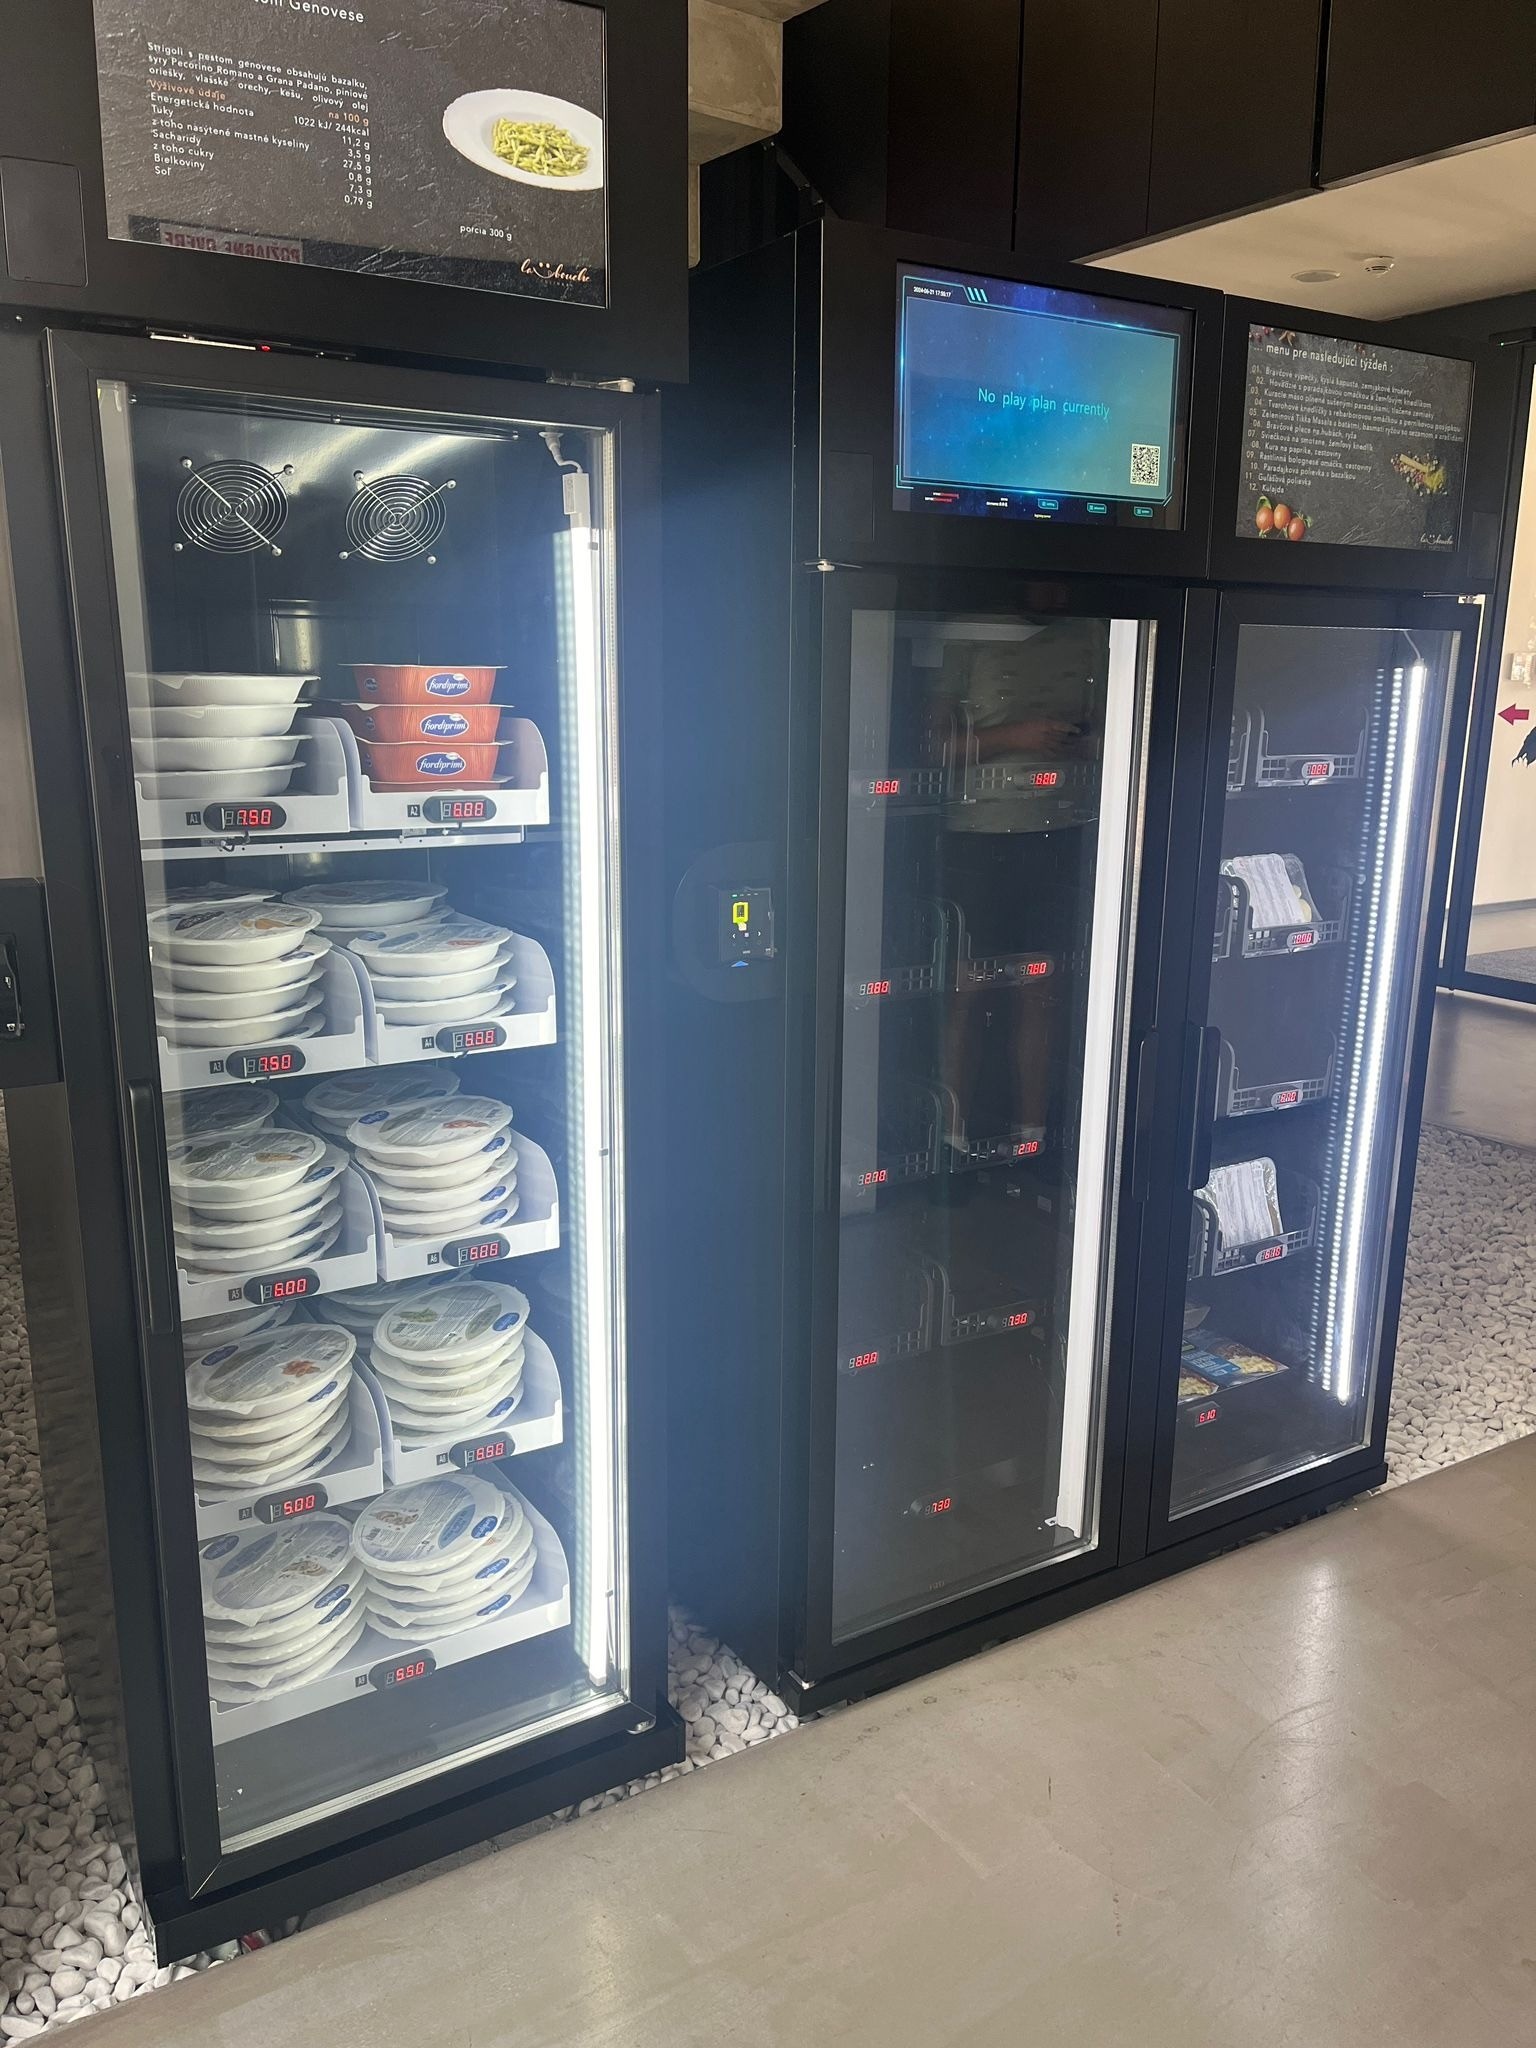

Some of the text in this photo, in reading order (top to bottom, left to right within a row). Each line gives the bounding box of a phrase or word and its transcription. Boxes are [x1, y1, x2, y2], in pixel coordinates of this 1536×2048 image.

[289, 0, 364, 23] Genovese
[148, 42, 183, 56] Strigoli
[198, 52, 233, 64] pestom
[238, 60, 282, 74] genovese
[287, 68, 327, 82] obsahujú
[331, 75, 368, 90] bazalku,
[148, 55, 167, 67] syry
[171, 58, 213, 73] Pecorino
[217, 66, 254, 79] Romano
[266, 74, 294, 87] Grana
[296, 80, 333, 95] Padano,
[335, 87, 368, 100] piniové
[149, 80, 226, 101] Výživové údaje
[195, 74, 229, 87] vlašské
[238, 82, 272, 95] orechy,
[280, 88, 303, 101] kešu,
[312, 95, 344, 108] olivový
[352, 102, 369, 113] olej
[150, 92, 254, 117] Energetická hodnota
[152, 104, 174, 117] Tuky
[294, 115, 315, 127] 1022
[335, 123, 370, 136] 244kcal
[343, 112, 360, 123] 100
[362, 118, 369, 127] g
[152, 129, 201, 147] Sacharidy
[160, 119, 184, 130] toho
[187, 123, 231, 137] nasýtené
[234, 131, 269, 143] mastné
[272, 136, 310, 152] kyseliny
[342, 136, 370, 151] 11,2 g
[161, 143, 185, 154] toho
[188, 148, 214, 160] cukry
[347, 149, 371, 162] 3,5 g
[154, 153, 205, 171] Bielkoviny
[342, 160, 371, 174] 27,5 g
[348, 172, 372, 186] 0,8 g
[349, 184, 372, 198] 7,3 g
[344, 195, 373, 209] 0,79 g
[460, 225, 512, 242] porcia 300 g
[1266, 344, 1290, 356] menu
[1292, 349, 1308, 360] pre
[1360, 358, 1388, 372] týždeň
[978, 388, 1110, 420] No play plan currently
[429, 677, 469, 693] fiordiprimi
[424, 716, 466, 734] fiordiprimi
[419, 757, 463, 772] fiordiprimi
[189, 813, 199, 824] A1
[410, 806, 419, 816] A2
[424, 1038, 433, 1047] A4
[212, 1062, 222, 1072] A3
[429, 1254, 438, 1263] A6
[231, 1290, 240, 1299] A5
[241, 1509, 250, 1519] A7
